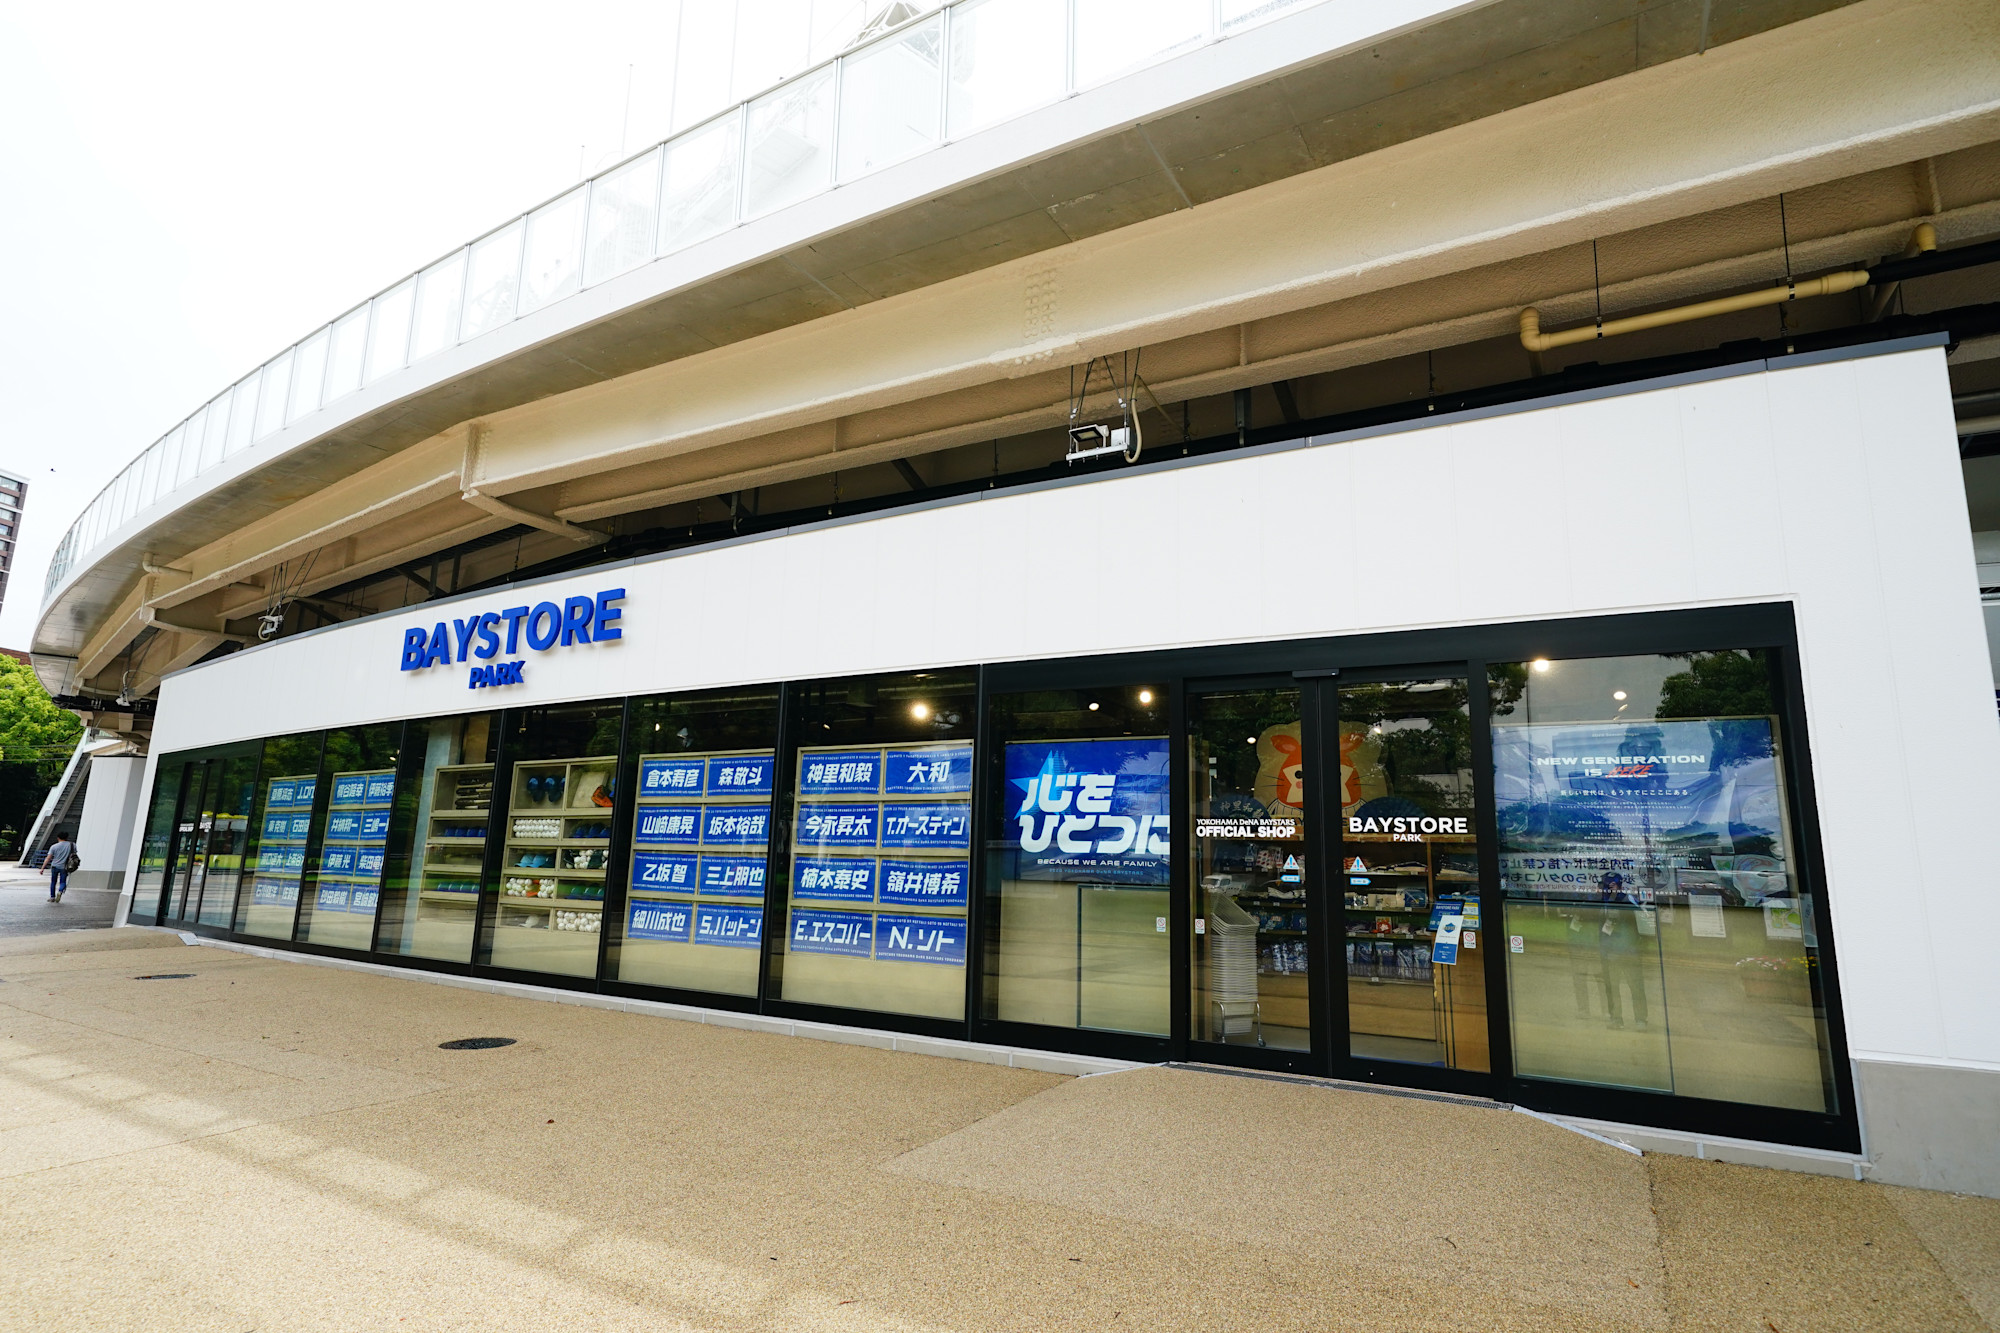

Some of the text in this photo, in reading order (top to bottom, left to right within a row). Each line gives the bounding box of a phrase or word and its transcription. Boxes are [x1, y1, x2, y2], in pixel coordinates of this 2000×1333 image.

[400, 587, 626, 672] BAYSTORE
[468, 660, 526, 690] PARK
[1537, 755, 1704, 766] NEW GENERATION
[646, 769, 700, 788] 倉本寿彦
[718, 766, 763, 786] 森敬斗
[807, 762, 873, 784] 神里和毅
[907, 761, 950, 783] 大和
[1584, 768, 1602, 776] IS
[1020, 774, 1116, 812] 心を
[364, 818, 390, 832] 三嶋一
[708, 815, 766, 836] 坂本裕哉
[805, 815, 872, 836] 今永昇太
[886, 816, 966, 836] T.オースティン
[1019, 814, 1170, 855] ひとつに
[1196, 826, 1296, 838] OFFICIAL SHOP
[1349, 817, 1468, 834] BAYSTORE
[1393, 834, 1422, 842] PARK
[359, 855, 384, 870] 柴田竜
[642, 863, 688, 884] 乙坂智
[705, 866, 764, 886] 三上朋也
[800, 868, 870, 890] 楠本泰史
[886, 870, 960, 895] 嶺井博希
[632, 909, 686, 932] 細川成也
[794, 920, 871, 945] E.エスコバー
[888, 926, 954, 952] N.ソト
